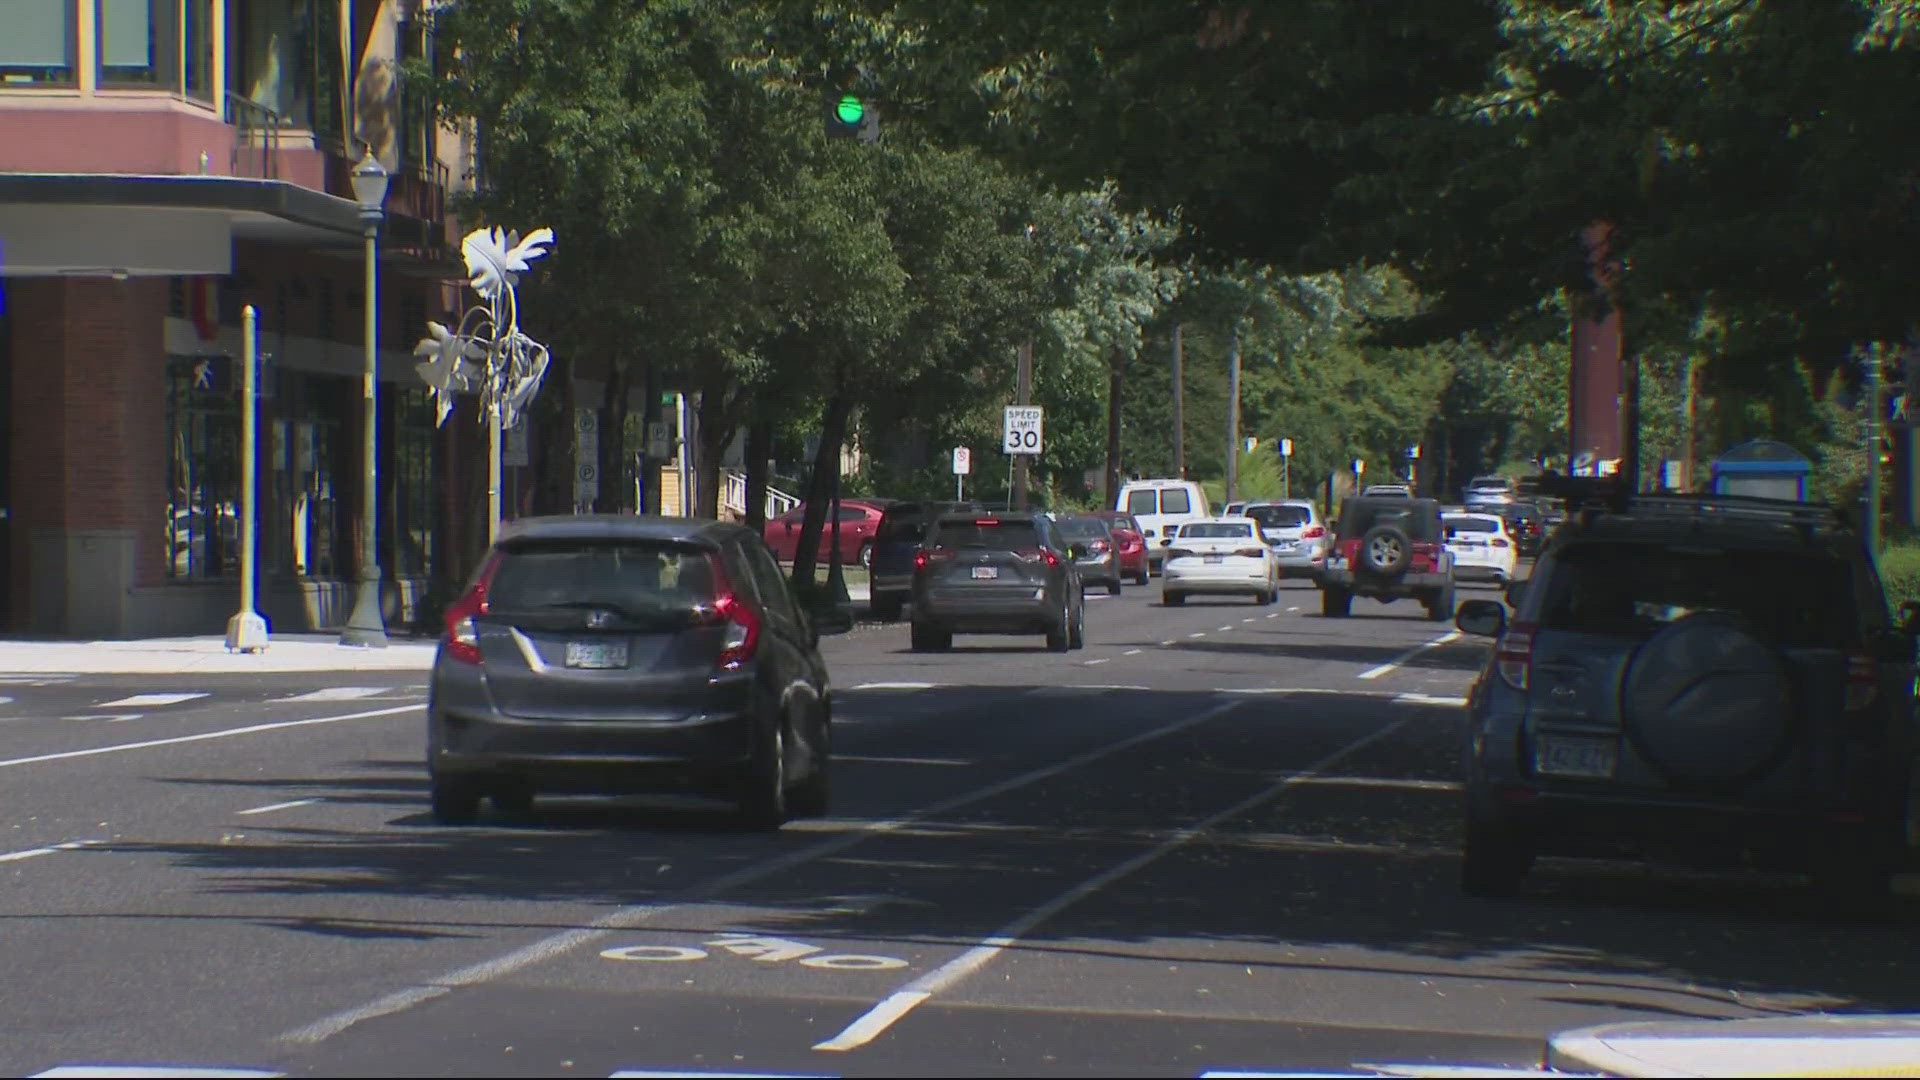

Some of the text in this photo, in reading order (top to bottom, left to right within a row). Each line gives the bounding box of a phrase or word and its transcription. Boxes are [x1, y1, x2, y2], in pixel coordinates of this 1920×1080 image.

[1008, 410, 1040, 420] SPEED
[1011, 420, 1036, 429] LIMIT
[1008, 430, 1038, 448] 30
